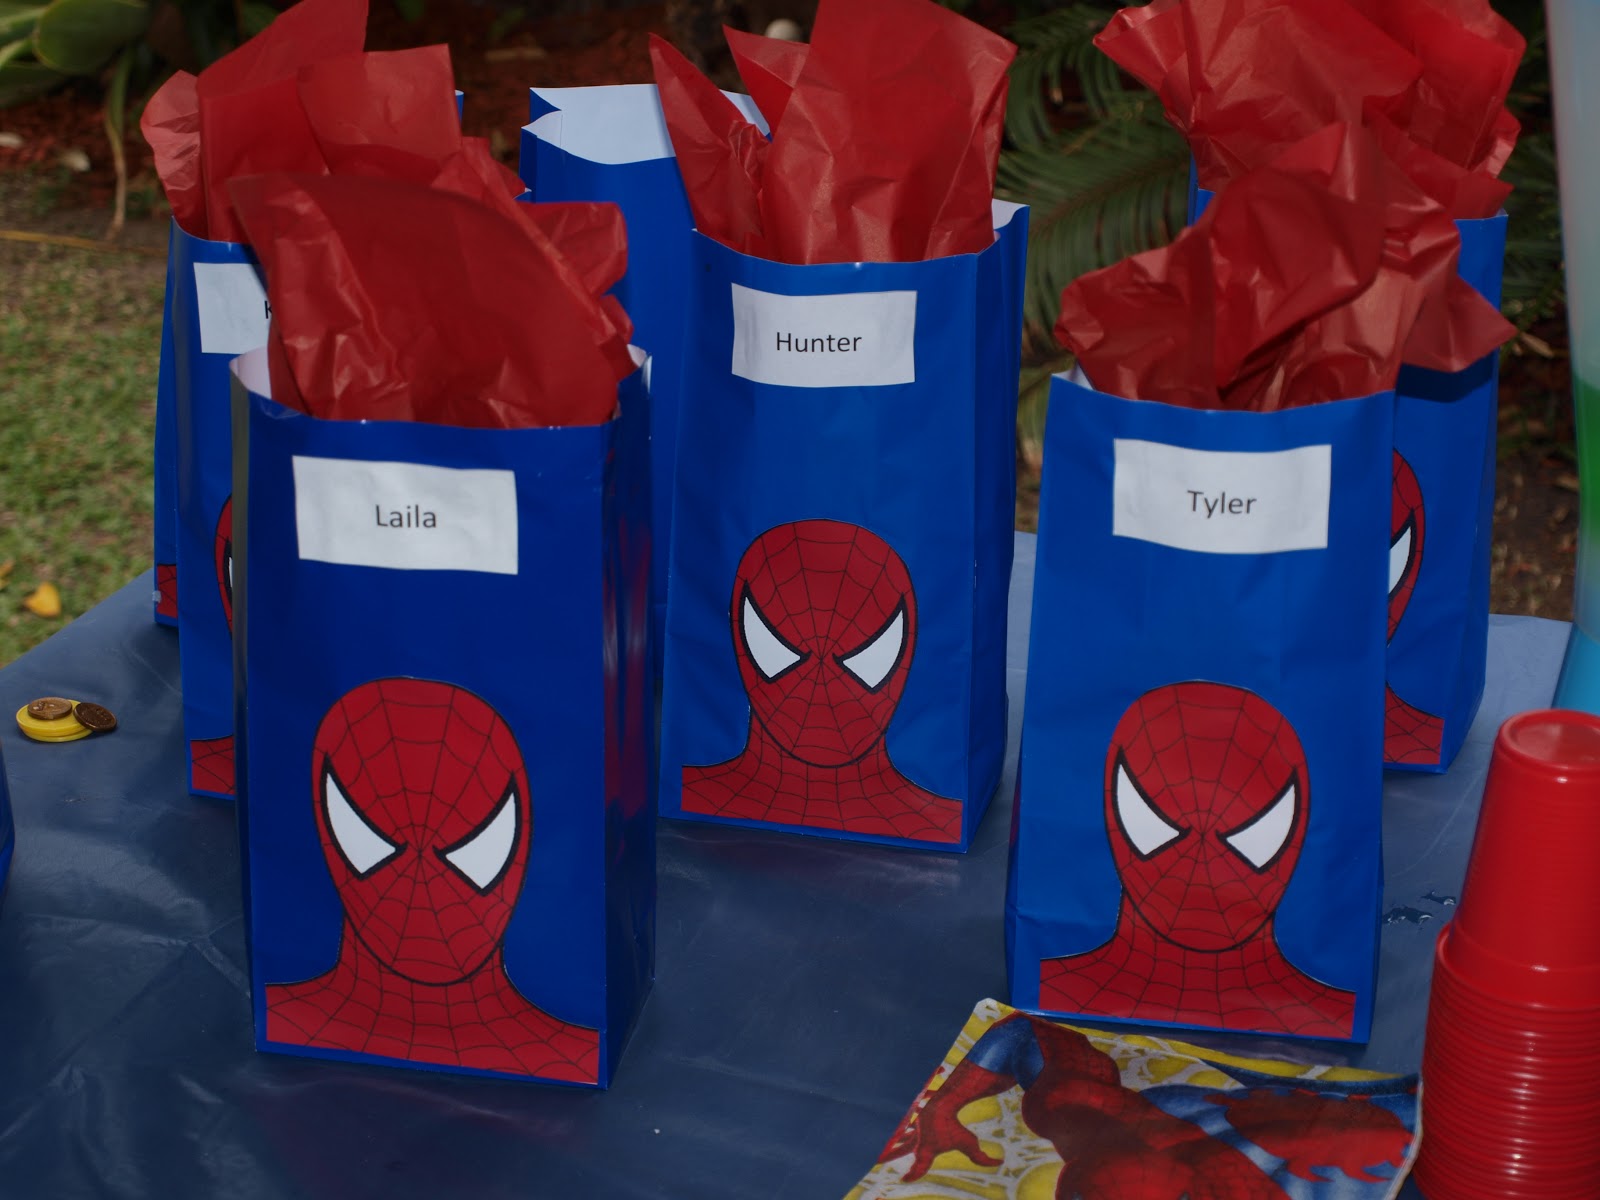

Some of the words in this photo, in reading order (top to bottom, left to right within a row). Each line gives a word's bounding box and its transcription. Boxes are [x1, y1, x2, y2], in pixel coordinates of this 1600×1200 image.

[776, 331, 862, 353] Hunter
[375, 504, 437, 529] Laila
[1187, 489, 1257, 519] Tyler
